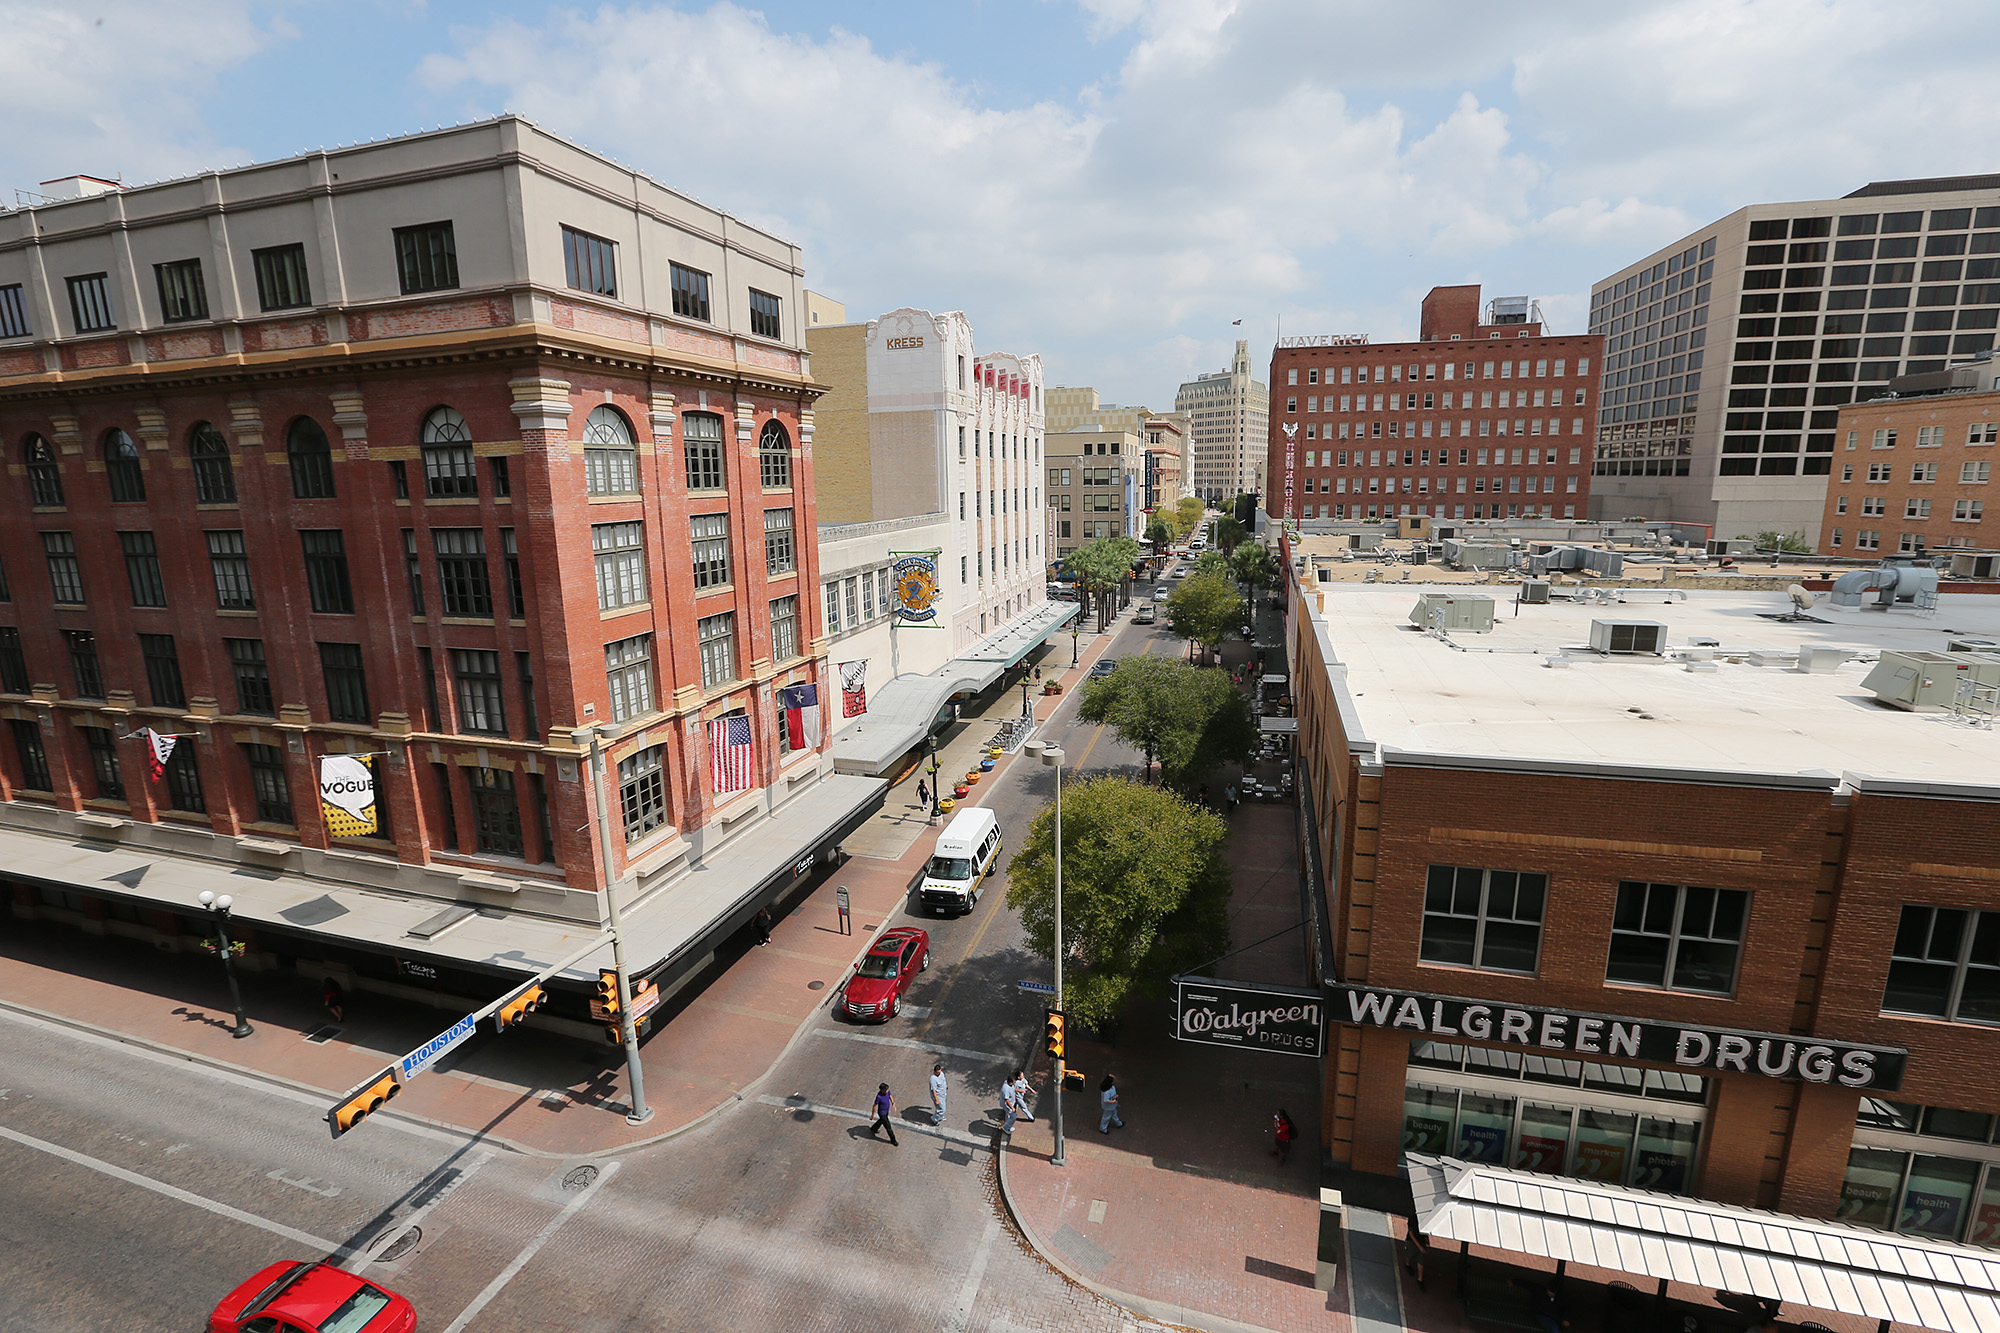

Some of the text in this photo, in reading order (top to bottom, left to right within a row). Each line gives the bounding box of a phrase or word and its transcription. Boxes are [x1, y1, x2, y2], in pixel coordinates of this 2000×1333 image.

[886, 336, 924, 350] KRESS
[1281, 333, 1370, 348] MAVERICK
[974, 363, 1030, 398] KRESS
[321, 780, 374, 794] VOGUE
[1021, 981, 1053, 991] NAVARRO
[1182, 1003, 1320, 1036] Walgreen
[409, 1018, 470, 1068] HOUSTON
[1259, 1031, 1315, 1049] DRUGS
[1347, 989, 1878, 1088] WALGREEN DRUGS
[1412, 1120, 1443, 1133] beauty
[1469, 1129, 1498, 1141] health
[1526, 1141, 1558, 1152] pharmacy
[1584, 1147, 1621, 1158] market
[1647, 1156, 1677, 1167] photo
[1845, 1185, 1883, 1200] beauty
[1915, 1196, 1951, 1209] health
